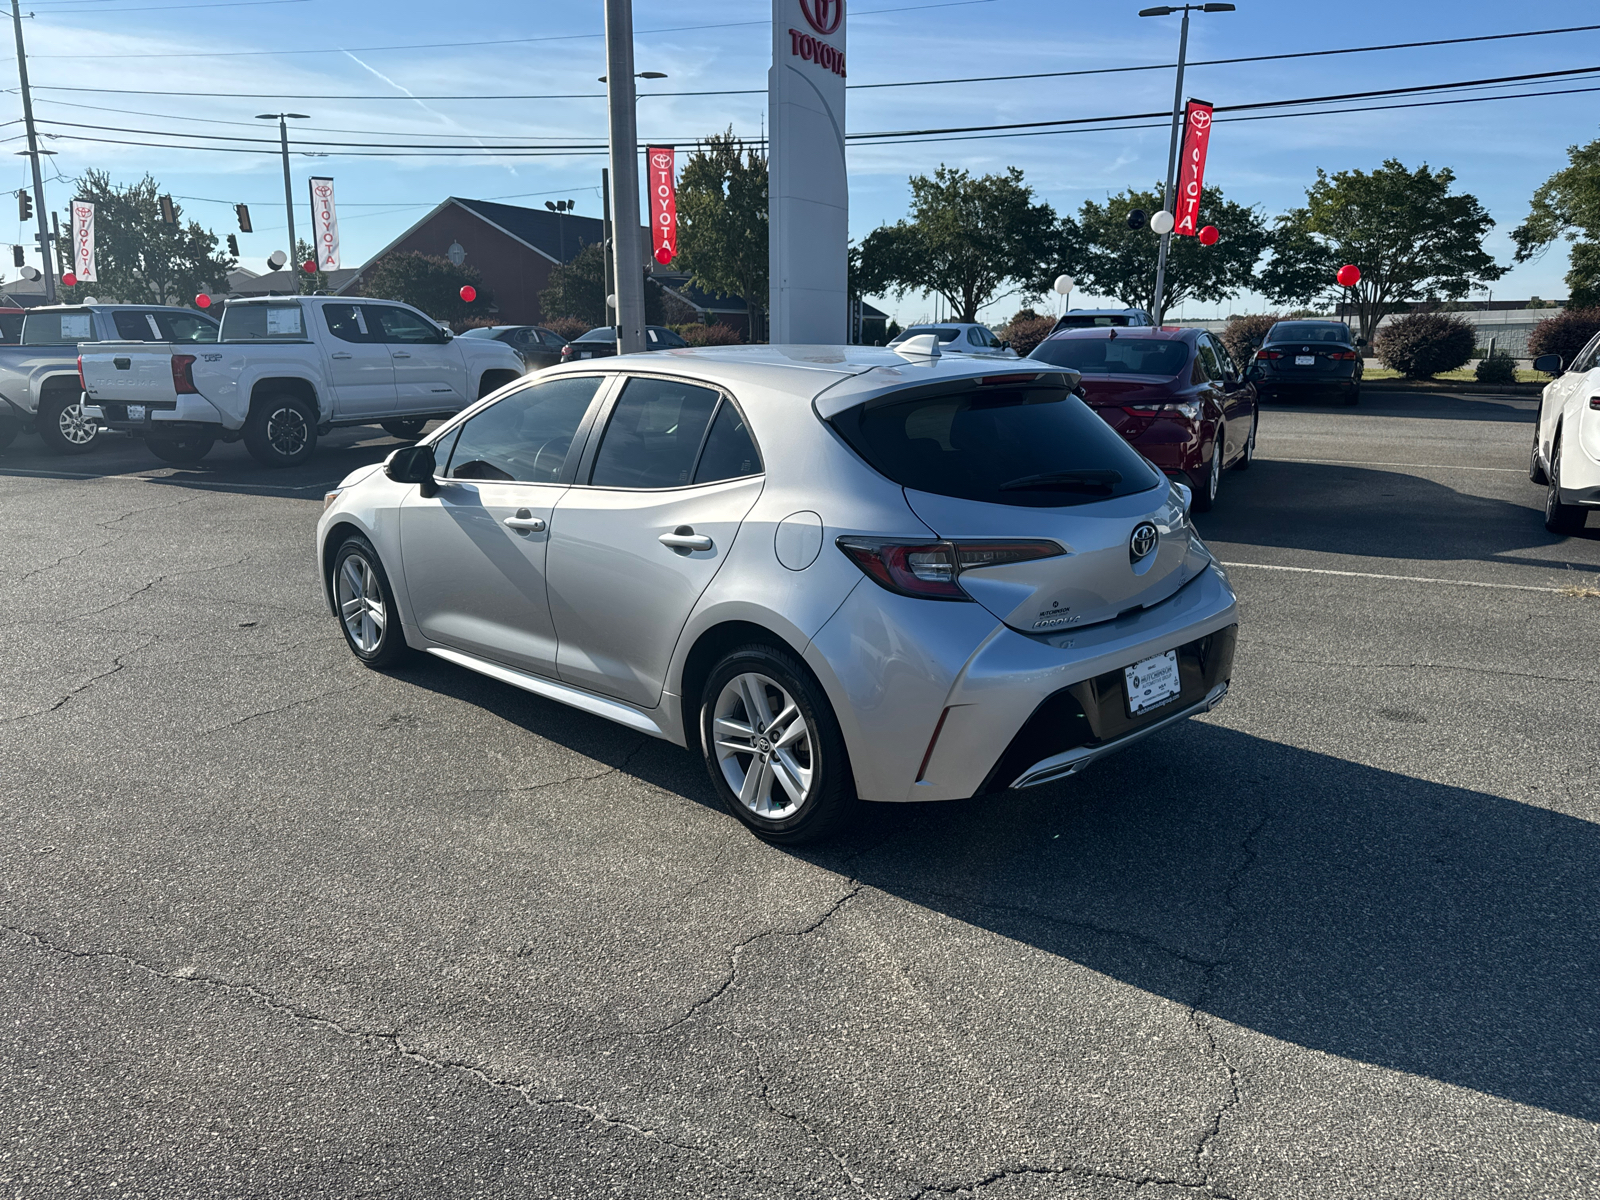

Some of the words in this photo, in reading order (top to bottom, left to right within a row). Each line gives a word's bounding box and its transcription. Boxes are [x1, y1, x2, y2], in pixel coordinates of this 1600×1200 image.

[789, 29, 847, 78] TOYOTA
[1178, 130, 1202, 230] TOYOTA
[320, 199, 336, 265] TOYOTA
[658, 171, 672, 252] TOYOTA
[79, 219, 91, 276] TOYOTA
[97, 379, 159, 387] TACOMA
[1039, 607, 1070, 617] HUTCHINSON
[1141, 665, 1173, 683] HUTCHINSON
[1142, 677, 1162, 689] AUTOMOTIVE
